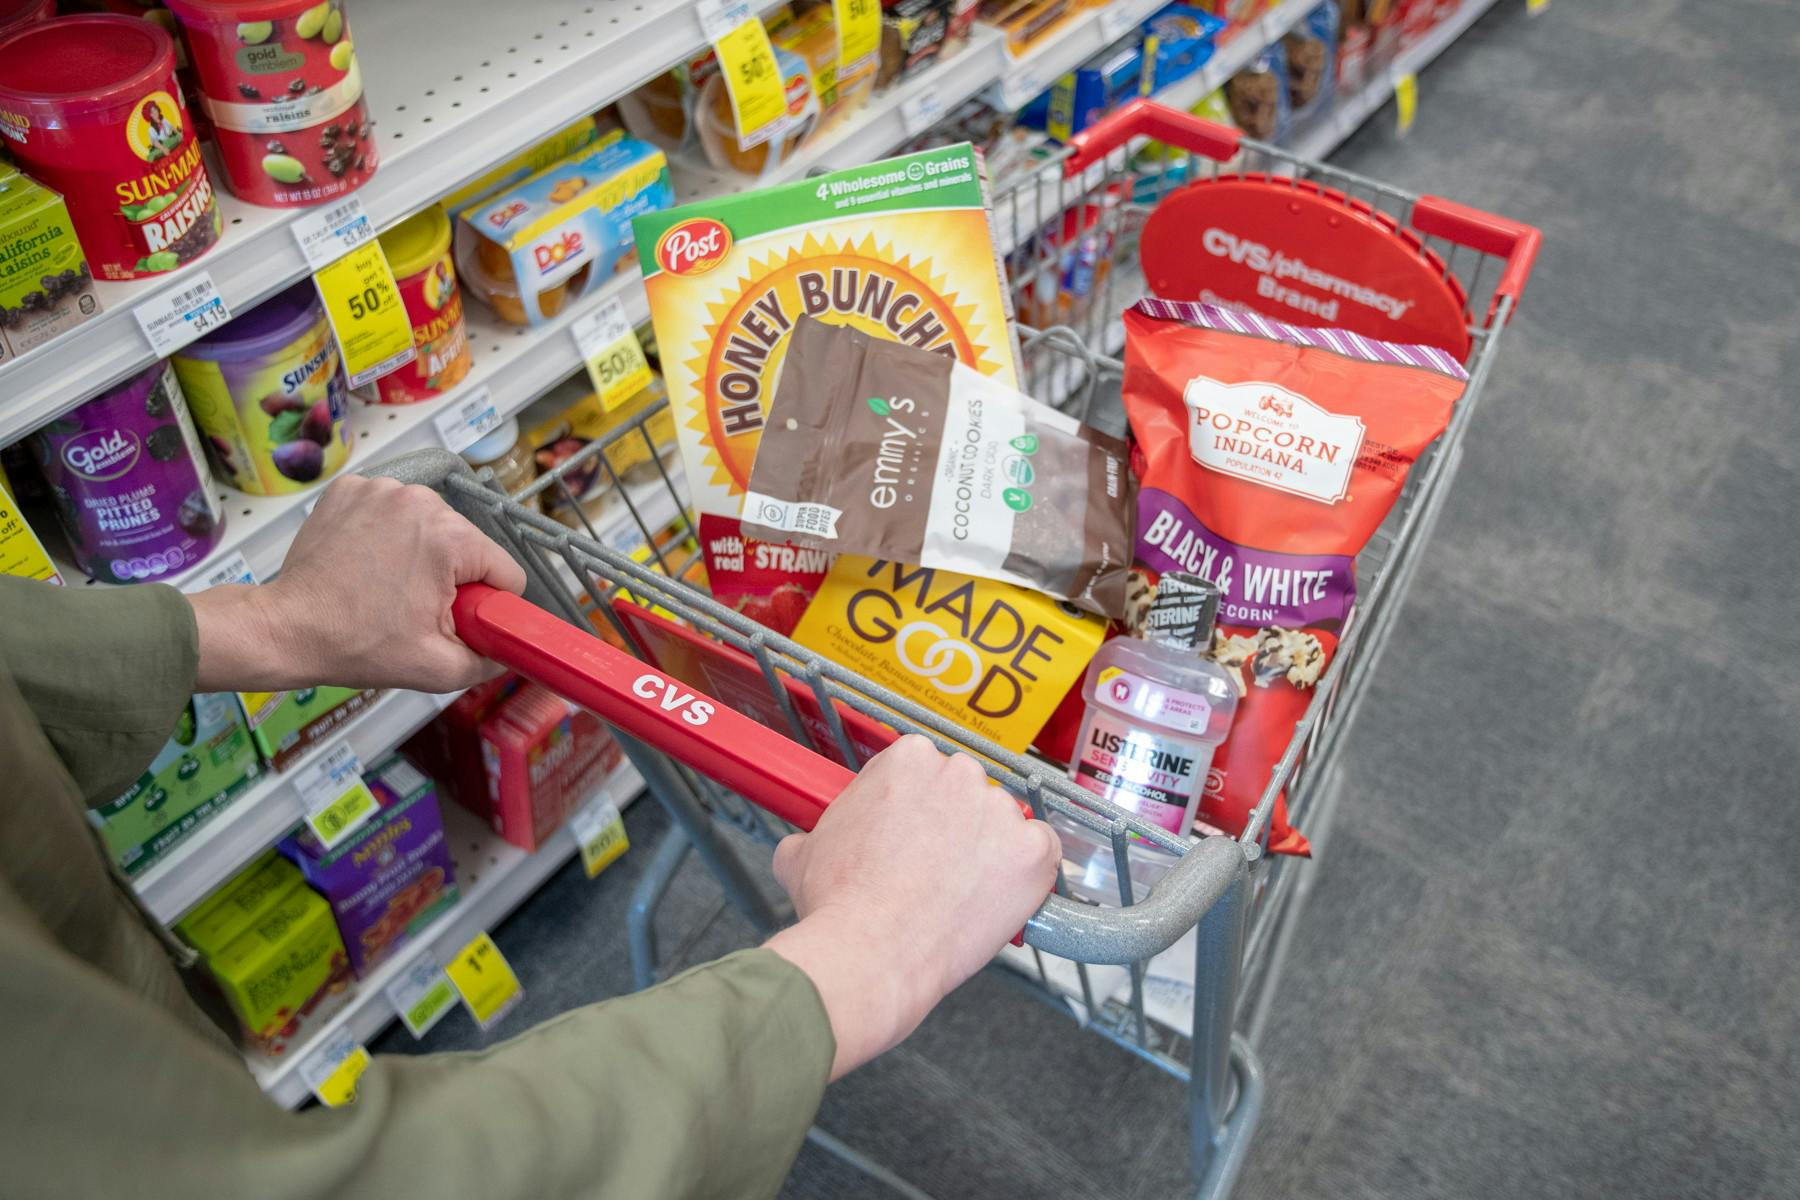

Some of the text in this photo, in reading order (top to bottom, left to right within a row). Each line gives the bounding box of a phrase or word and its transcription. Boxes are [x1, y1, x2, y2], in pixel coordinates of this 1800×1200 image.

[247, 49, 277, 64] gold
[265, 108, 311, 124] raisins
[815, 156, 970, 201] 4 Wholesome Grains
[142, 173, 212, 254] RAISINS
[490, 201, 529, 227] Dole
[533, 231, 585, 273] Dole
[665, 226, 721, 271] Post
[1202, 227, 1412, 321] CVS/pharmacy
[193, 304, 228, 332] $4.19
[1256, 274, 1340, 322] Brand
[720, 289, 791, 435] HONEY
[67, 429, 129, 475] Gold
[1195, 406, 1342, 464] POPCORN
[1214, 435, 1304, 474] INDIANA
[95, 445, 137, 471] emblem
[118, 483, 157, 505] PLUMS
[952, 462, 976, 542] COCONUT
[980, 466, 996, 500] DARK
[97, 498, 153, 519] PITTED
[98, 507, 161, 532] PRUNES
[805, 506, 820, 531] FOOD
[818, 509, 832, 534] BITES
[710, 536, 744, 554] with
[714, 554, 745, 573] real
[1143, 510, 1219, 584] BLACK
[1215, 555, 1234, 595] &
[1244, 562, 1334, 607] WHITE
[867, 560, 1064, 682] MADE
[847, 588, 1024, 719] GOOD
[632, 674, 716, 726] CVS
[826, 624, 879, 662] Chocolate
[879, 659, 923, 692] Banana
[924, 688, 968, 721] Granola
[969, 714, 1002, 741] Minis
